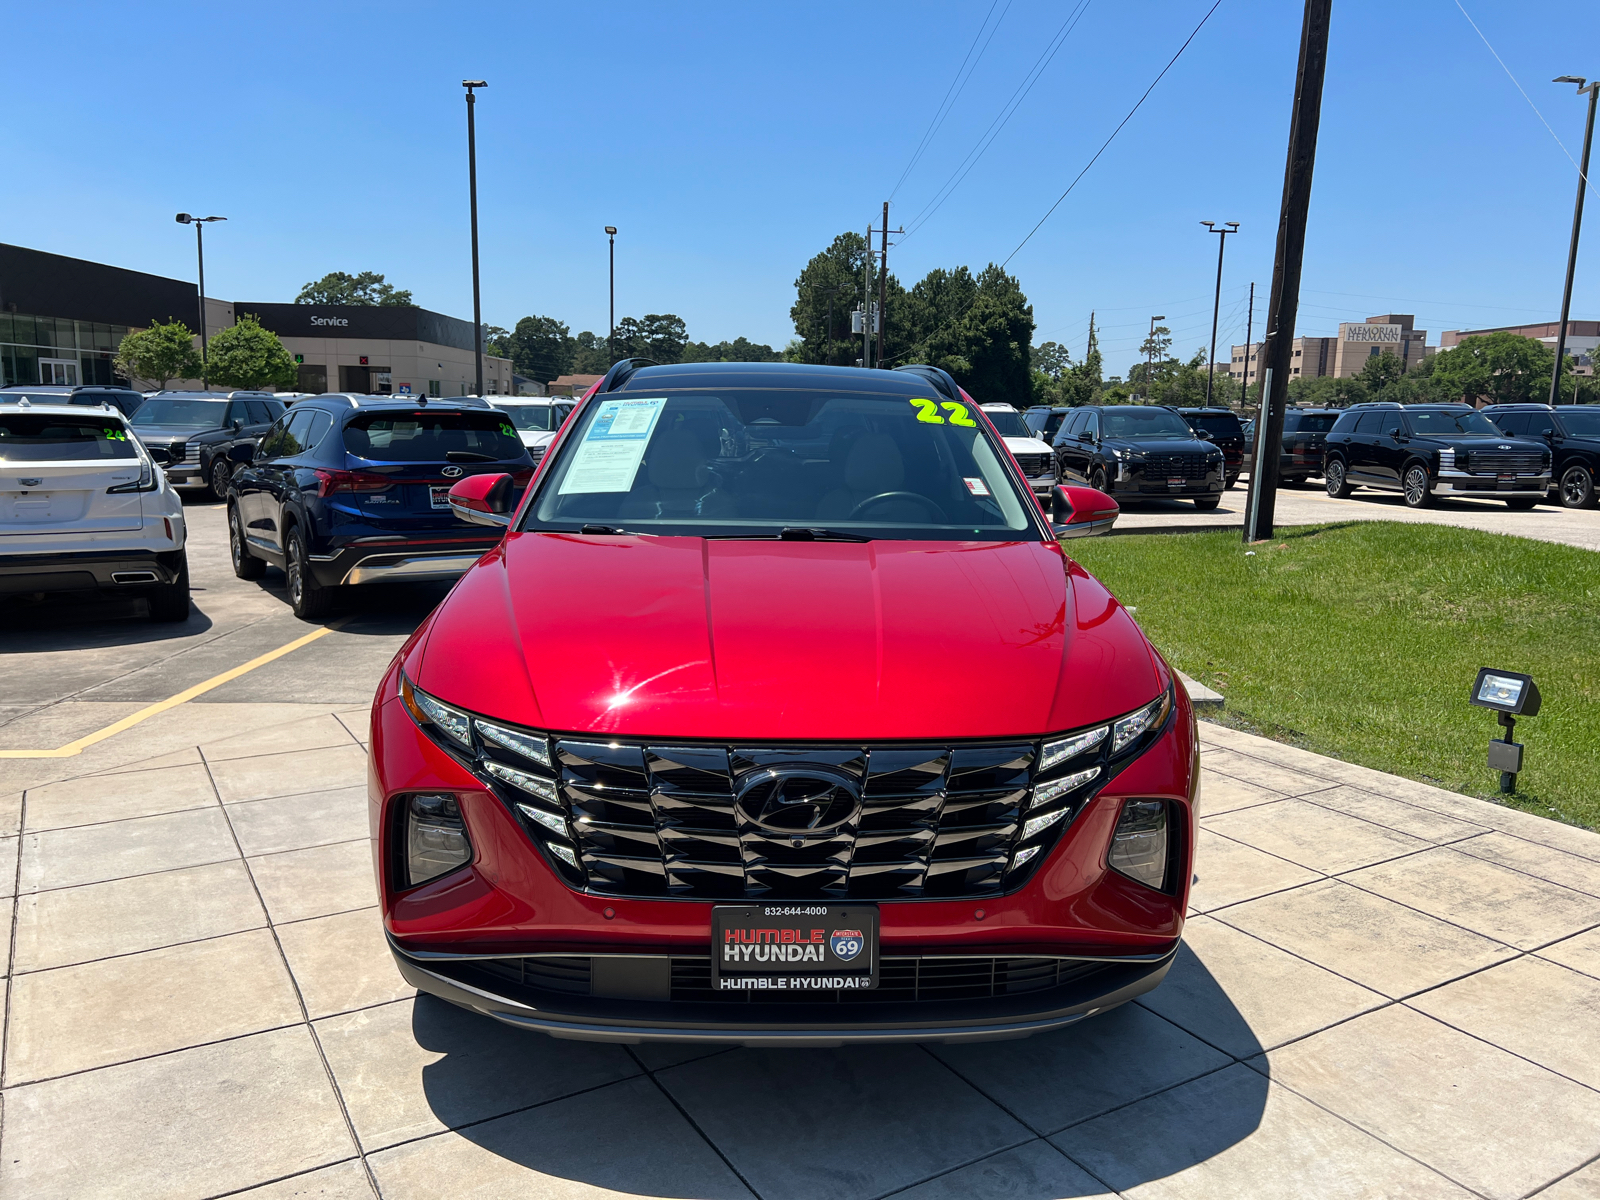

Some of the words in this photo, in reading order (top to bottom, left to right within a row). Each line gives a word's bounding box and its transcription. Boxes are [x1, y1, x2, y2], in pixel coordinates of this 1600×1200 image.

[310, 315, 349, 327] Service
[1347, 333, 1398, 342] HERMANN
[1348, 327, 1399, 335] MEMORIAL
[909, 398, 977, 428] 22
[104, 428, 126, 442] 24
[499, 423, 517, 438] 22
[765, 907, 828, 916] 832-644-4000
[725, 929, 825, 943] HUMBLE
[724, 944, 825, 962] HYUNDAI
[835, 940, 859, 955] 69
[720, 978, 787, 989] HUMBLE
[790, 977, 859, 989] HYUNDAI
